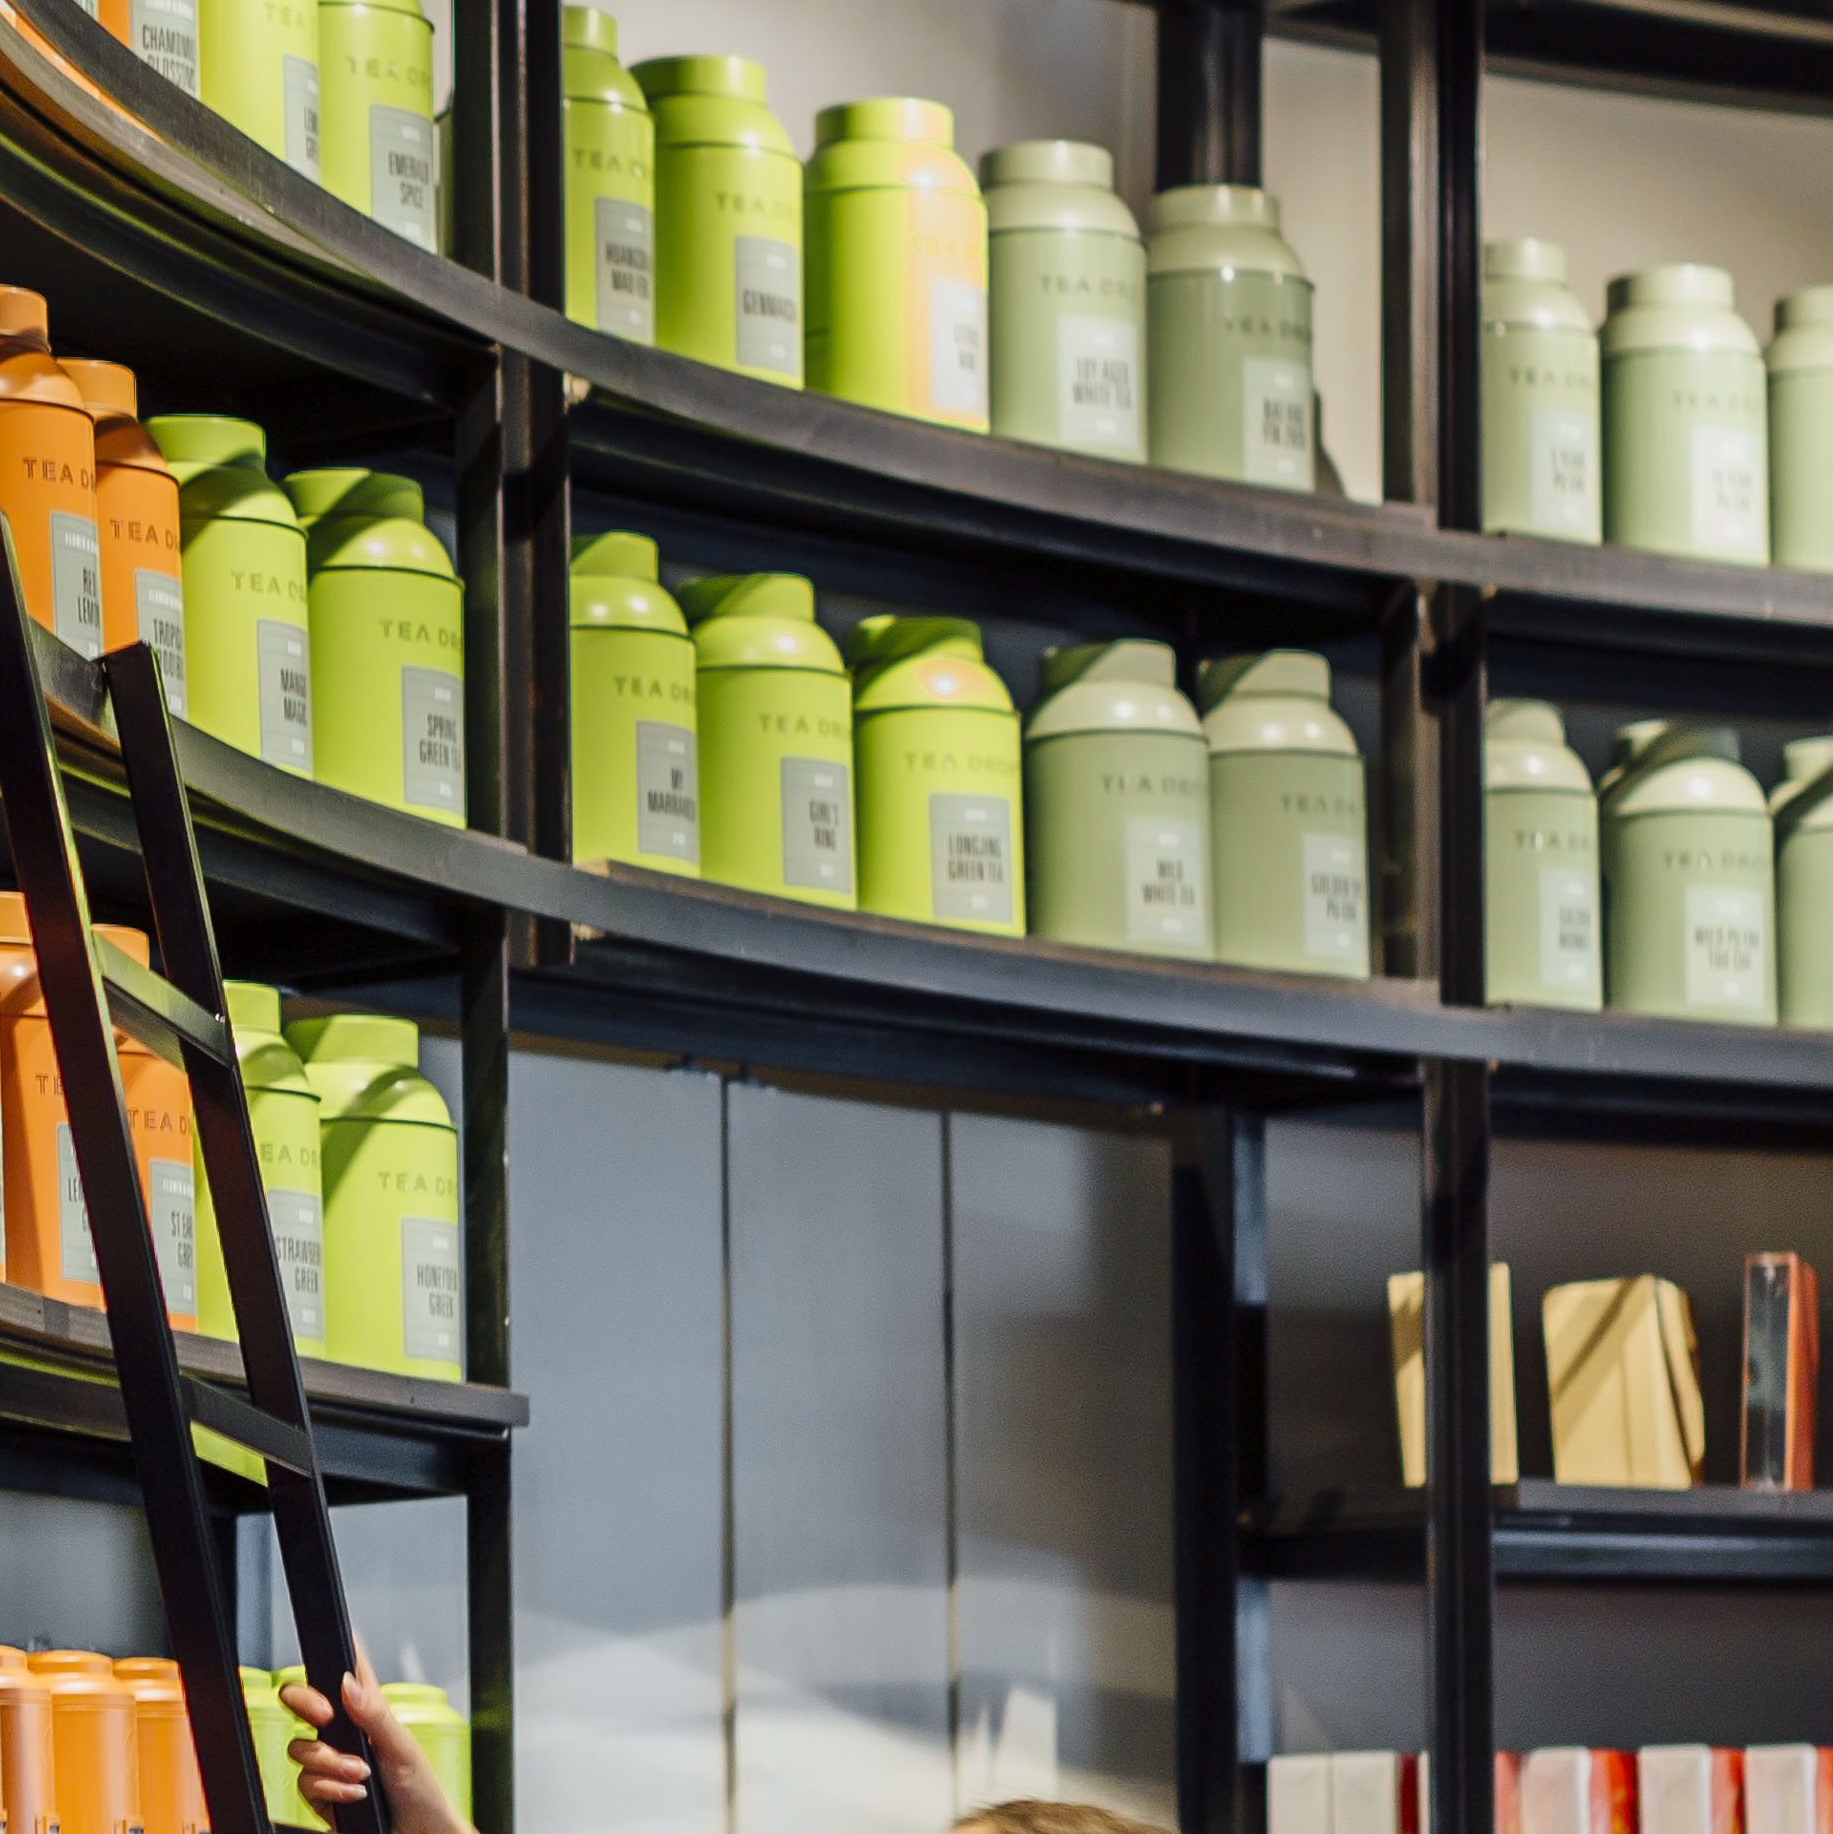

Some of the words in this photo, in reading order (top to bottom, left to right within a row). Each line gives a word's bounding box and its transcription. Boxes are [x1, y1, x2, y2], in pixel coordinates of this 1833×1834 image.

[346, 56, 400, 82] TEA
[573, 148, 622, 173] TEA
[1040, 273, 1092, 296] TEA
[23, 456, 74, 485] TEA
[110, 519, 159, 547] TEA
[231, 570, 281, 596] TEA
[379, 619, 431, 643] TEA
[614, 677, 663, 698] TEA
[759, 713, 810, 734] TEA
[419, 740, 450, 767] GREEN
[905, 751, 957, 772] TEA
[948, 857, 985, 882] GREEN
[36, 1073, 64, 1096] TE
[127, 1109, 173, 1131] TEA
[260, 1144, 292, 1165] EA
[378, 1171, 428, 1193] TEA
[275, 1236, 321, 1267] STRAWBER
[294, 1266, 318, 1294] GREEN
